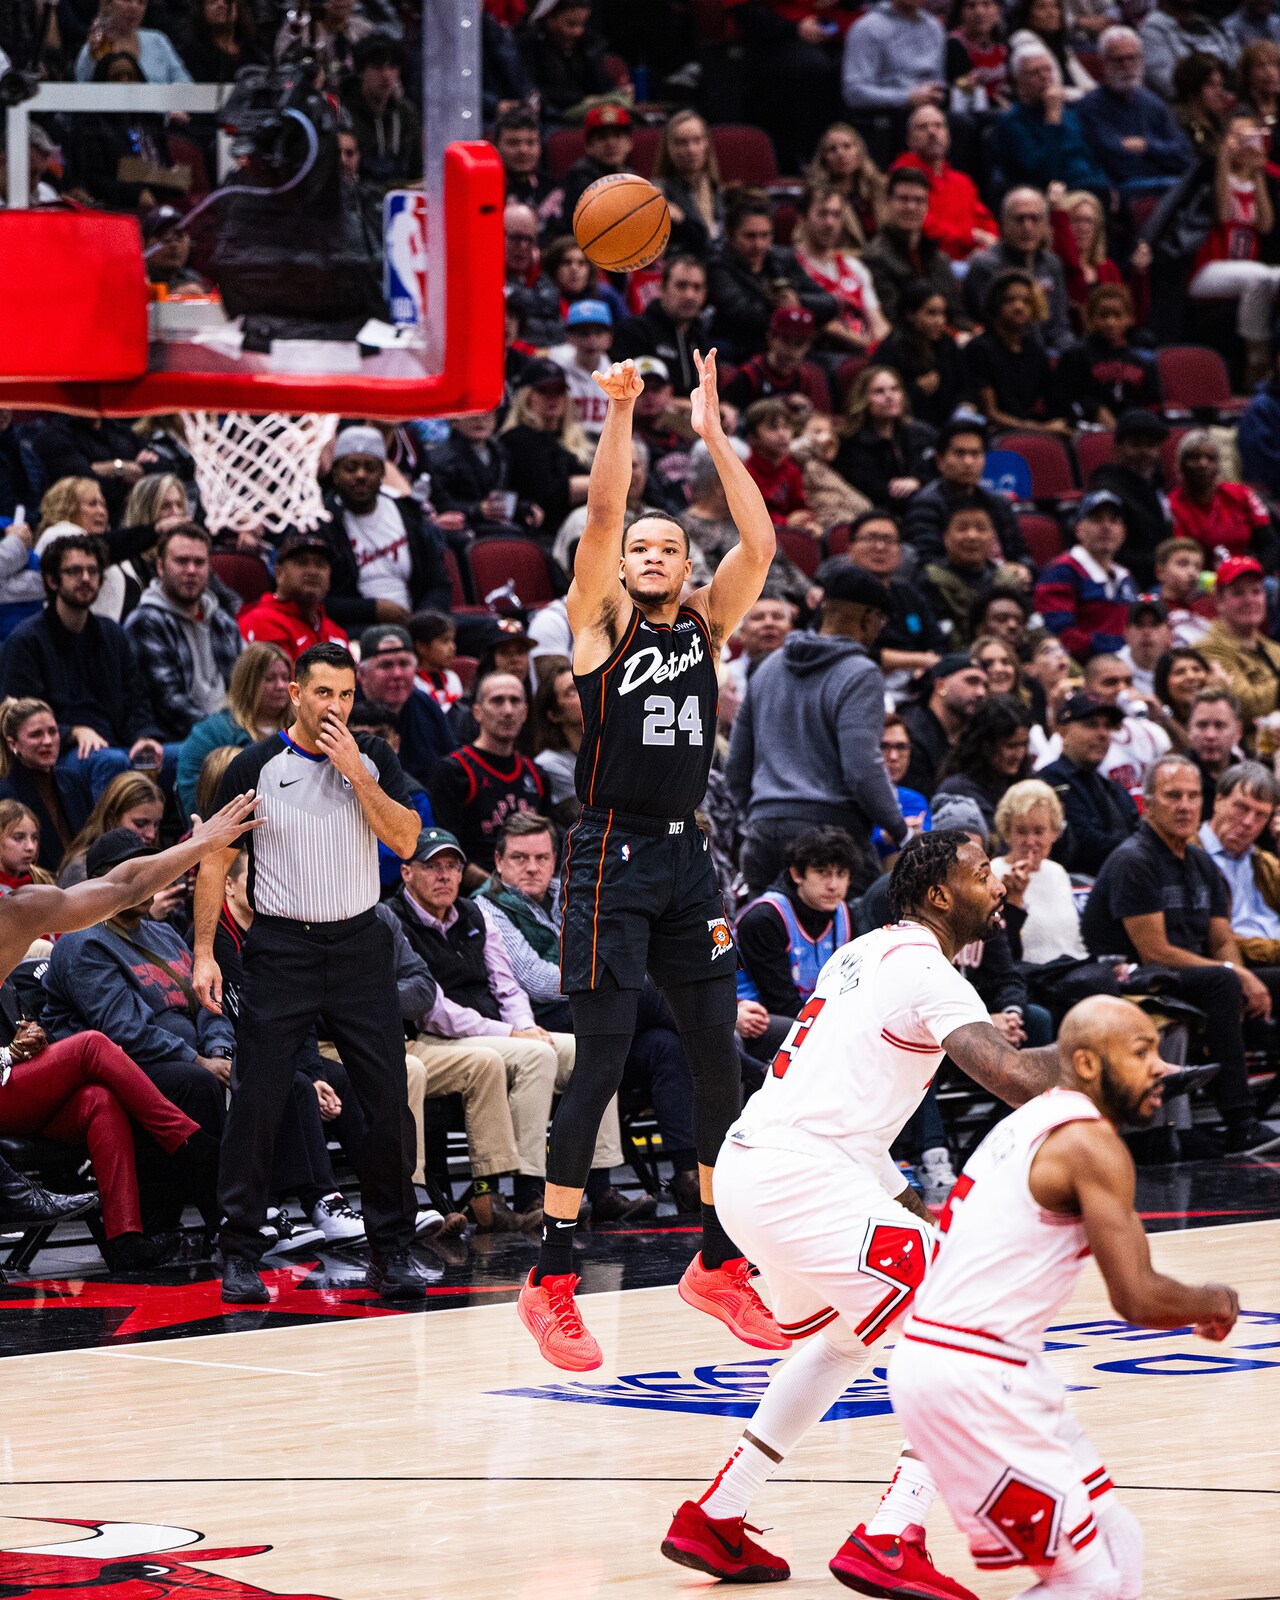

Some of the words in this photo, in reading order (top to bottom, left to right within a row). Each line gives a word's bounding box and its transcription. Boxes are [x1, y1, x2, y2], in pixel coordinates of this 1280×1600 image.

[617, 633, 704, 696] Detroit
[642, 694, 703, 746] 24
[668, 821, 685, 835] DET
[771, 996, 828, 1080] 3
